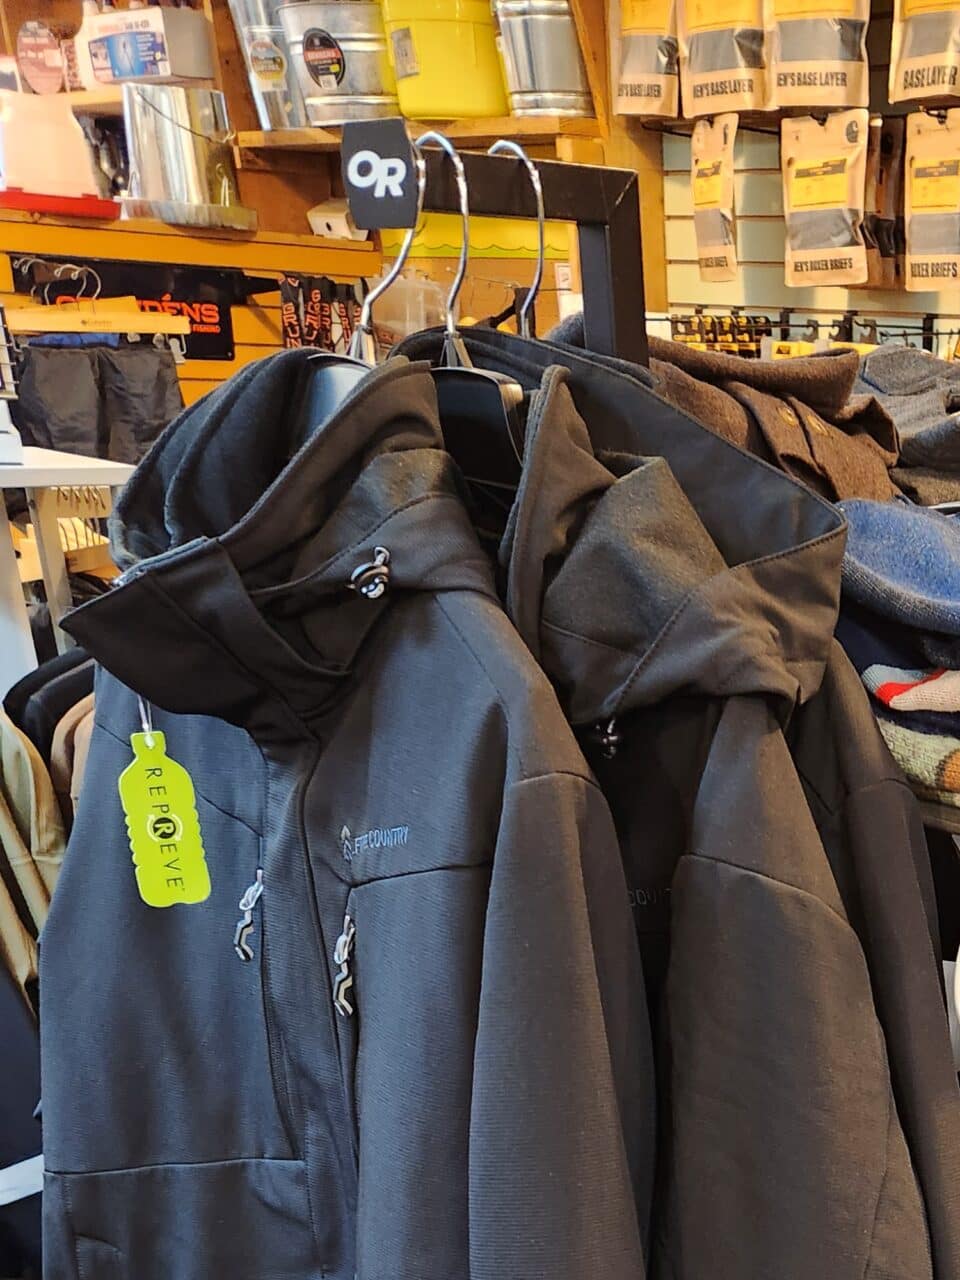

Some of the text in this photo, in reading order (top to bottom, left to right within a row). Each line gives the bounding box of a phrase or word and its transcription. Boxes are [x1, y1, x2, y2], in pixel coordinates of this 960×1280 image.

[797, 72, 817, 86] BASE
[819, 72, 847, 86] LAYER
[347, 150, 407, 197] OR
[145, 767, 185, 890] REPREVE
